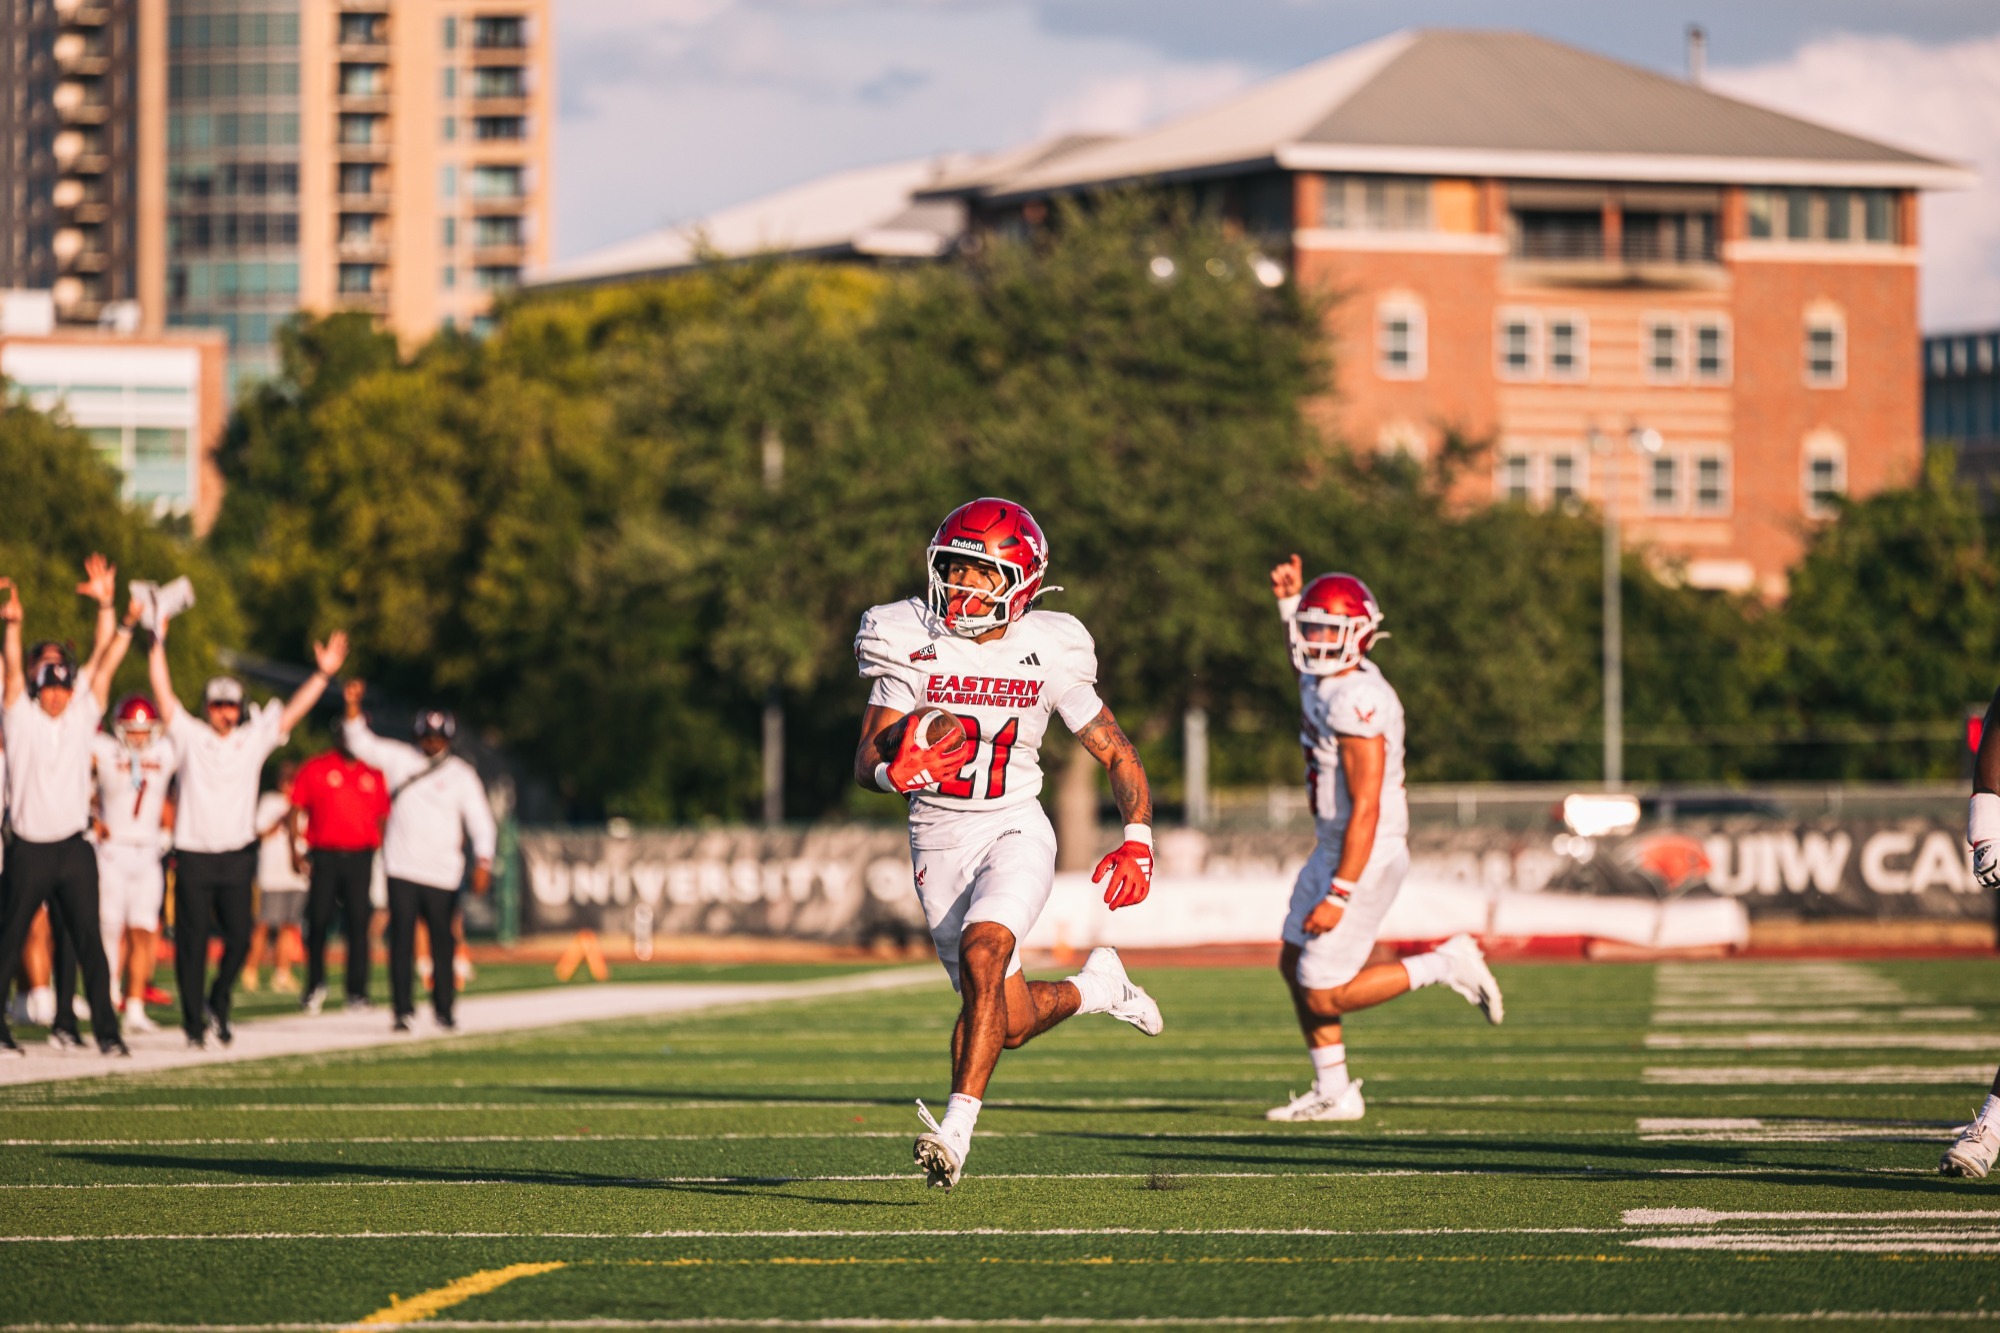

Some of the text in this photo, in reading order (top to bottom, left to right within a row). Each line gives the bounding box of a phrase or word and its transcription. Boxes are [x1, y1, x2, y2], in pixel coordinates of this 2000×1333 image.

[951, 538, 984, 552] Riddell
[926, 674, 1045, 697] EASTERN
[926, 691, 1040, 709] WASHINGTON
[937, 713, 1020, 800] 21
[1705, 830, 1982, 895] UIW CA
[531, 861, 854, 907] UNIVERSITY
